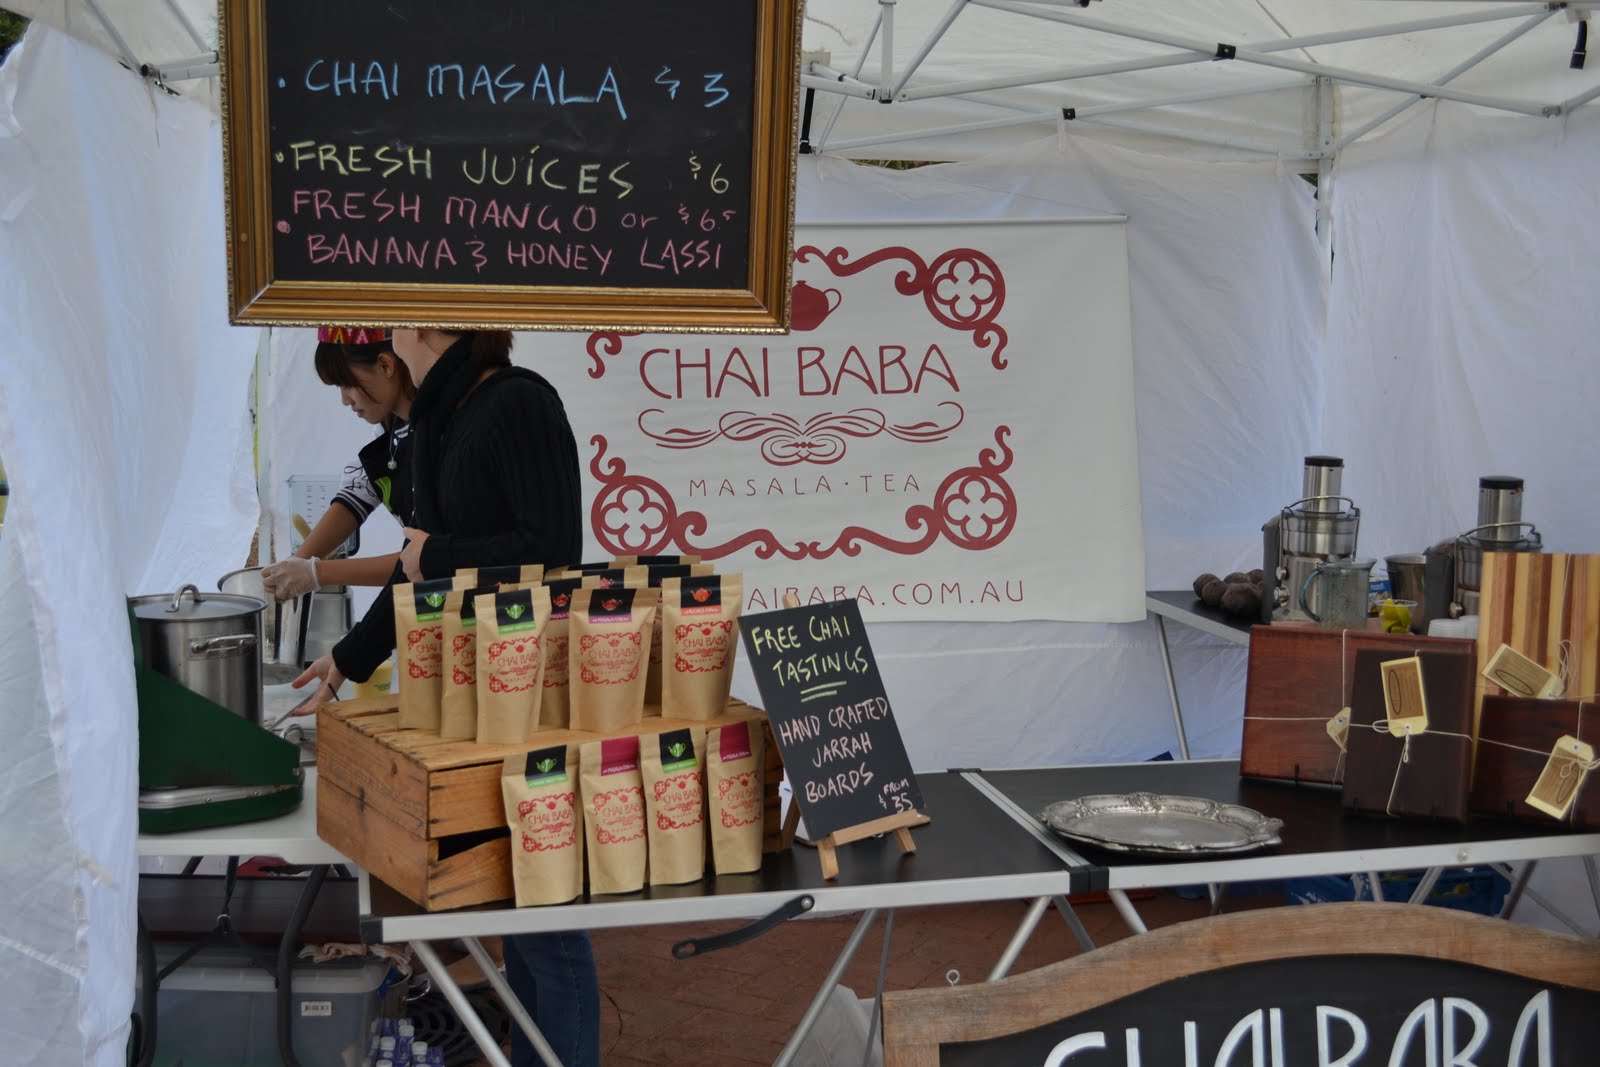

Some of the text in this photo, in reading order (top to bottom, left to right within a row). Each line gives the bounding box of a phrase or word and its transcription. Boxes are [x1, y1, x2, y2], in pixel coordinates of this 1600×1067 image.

[305, 60, 399, 100] CHAI
[427, 63, 627, 120] MASALA
[290, 141, 432, 179] FRESH
[462, 146, 633, 199] JUICES
[292, 189, 421, 224] FRESH
[445, 197, 597, 234] MANGO
[307, 233, 457, 270] BANANA
[508, 239, 613, 276] HONEY
[640, 237, 722, 275] LASSI
[639, 343, 961, 400] CHAI BABA
[689, 473, 921, 498] MASALA TEA
[751, 615, 851, 656] FREE CHAI
[772, 645, 870, 687] TASTINGS
[778, 696, 889, 747] HAND CRAFTED
[811, 731, 873, 768] JARRAH
[804, 761, 875, 804] BOARDS
[882, 777, 910, 796] FROM
